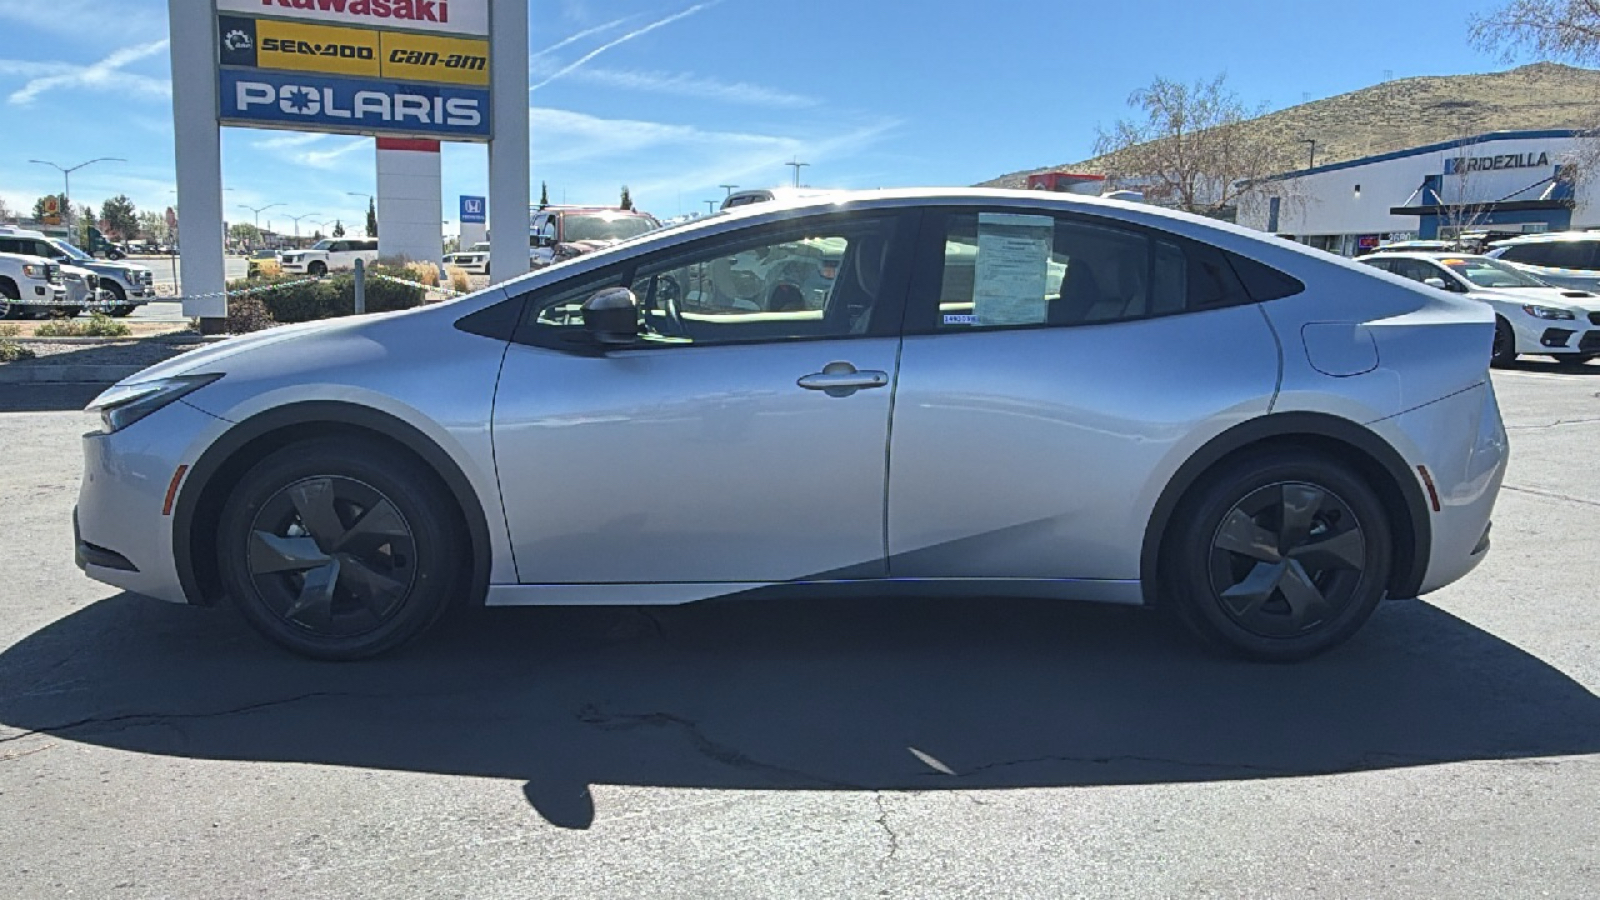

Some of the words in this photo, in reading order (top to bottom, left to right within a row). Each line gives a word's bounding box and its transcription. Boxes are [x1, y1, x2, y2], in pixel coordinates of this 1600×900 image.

[262, 0, 448, 23] wasaki
[235, 81, 481, 126] POLARIS
[1467, 152, 1549, 171] RIDEZILLA
